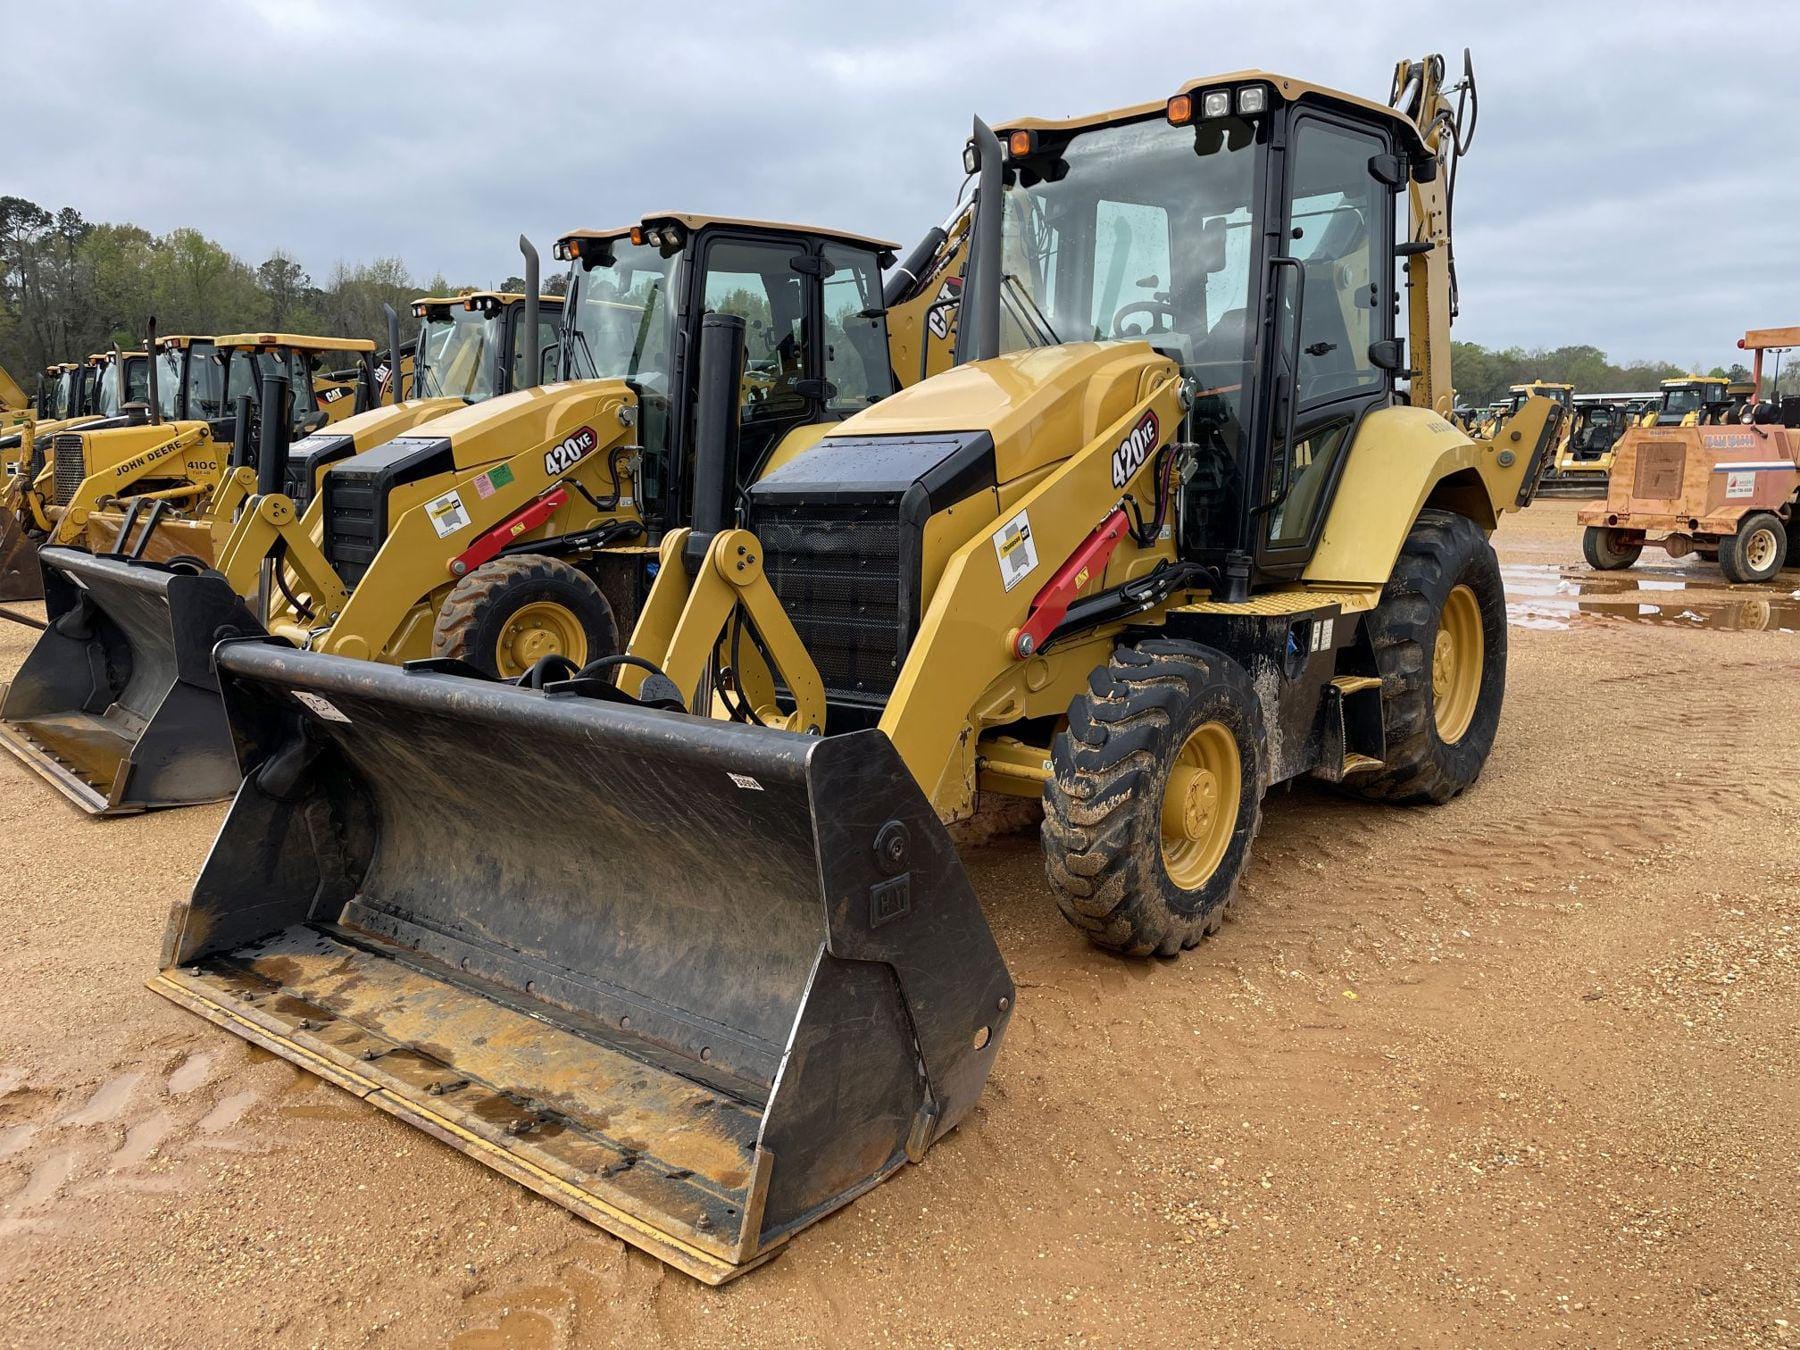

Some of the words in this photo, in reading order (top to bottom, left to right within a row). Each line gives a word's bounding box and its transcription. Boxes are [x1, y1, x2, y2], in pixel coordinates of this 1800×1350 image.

[929, 283, 959, 338] CAT
[374, 364, 389, 382] CAT
[325, 387, 342, 403] CAT
[116, 457, 145, 476] JOHN
[147, 440, 182, 461] DEERE
